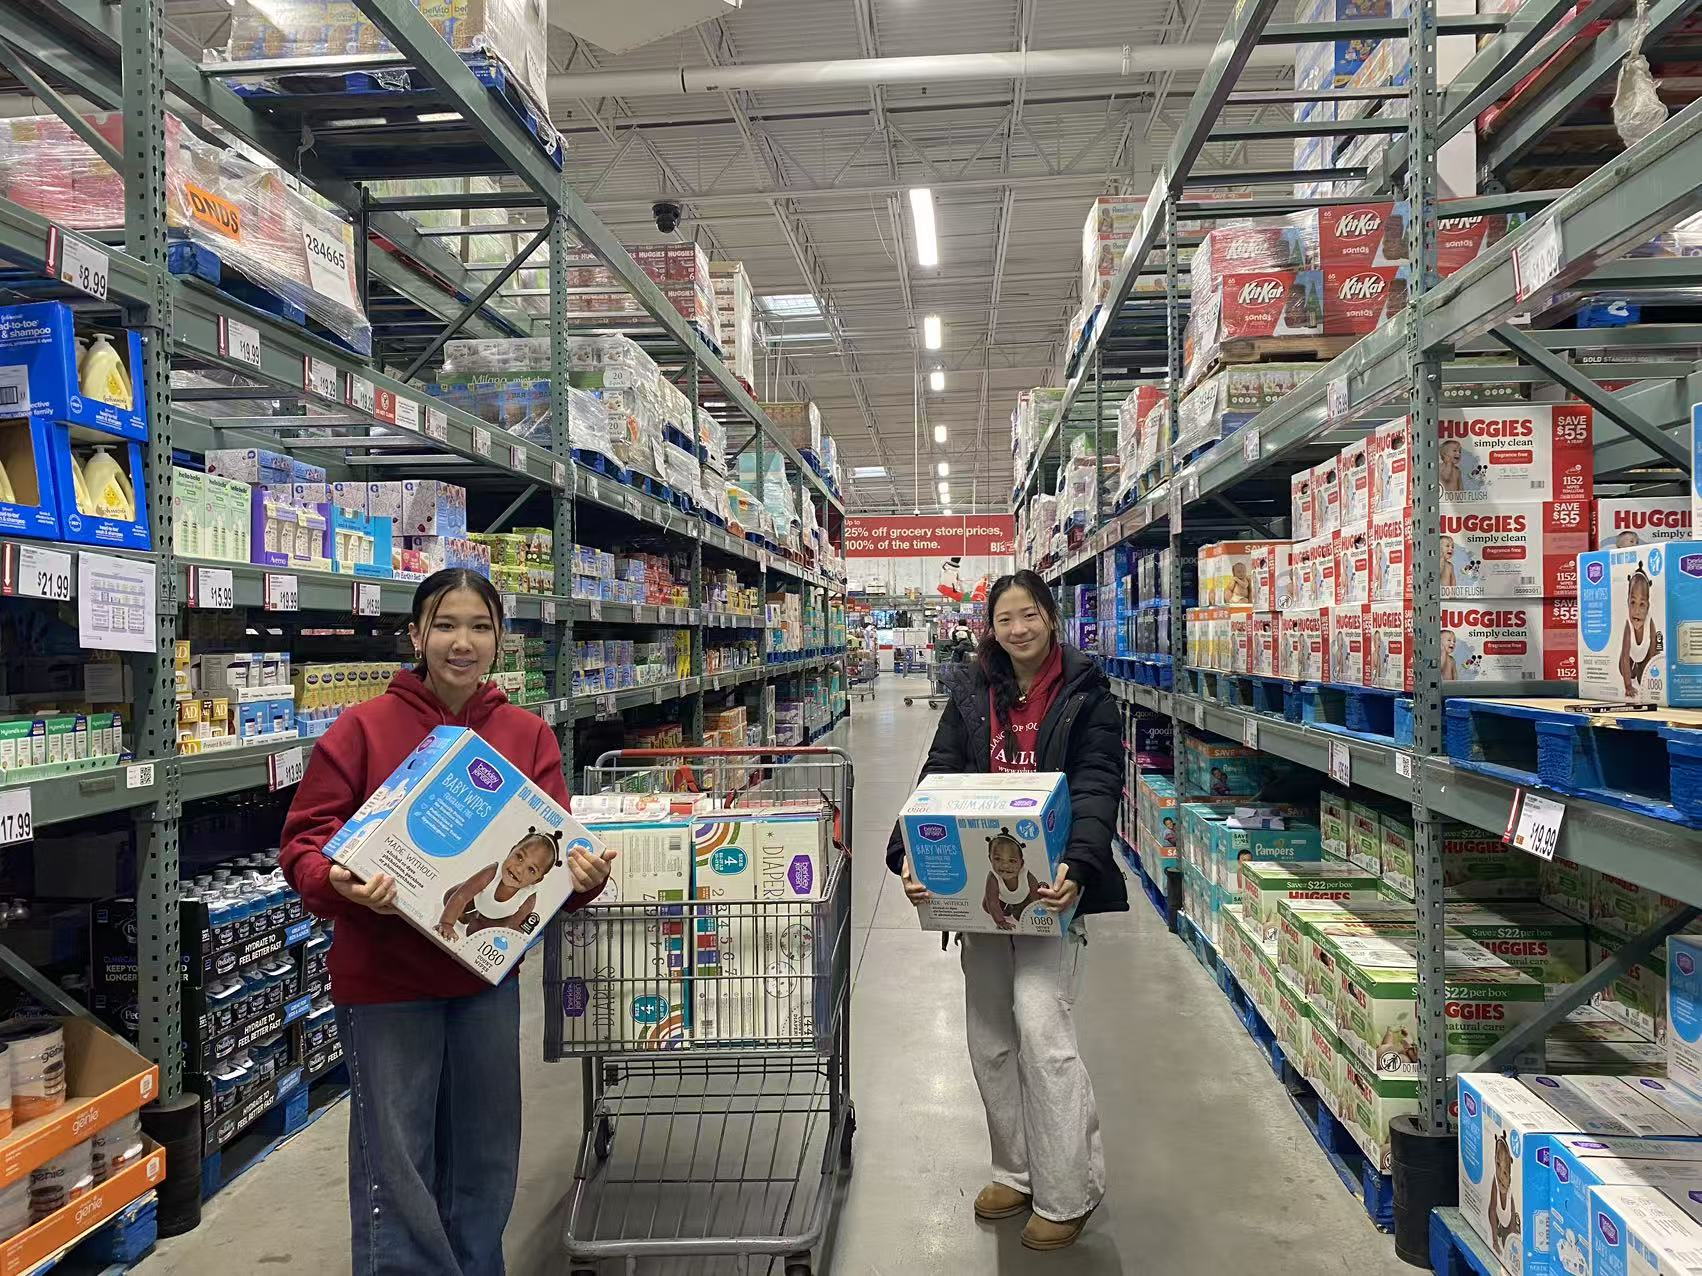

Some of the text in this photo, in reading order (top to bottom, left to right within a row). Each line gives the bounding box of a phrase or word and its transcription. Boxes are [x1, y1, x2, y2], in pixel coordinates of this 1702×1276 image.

[190, 191, 239, 234] DNDS
[1336, 214, 1382, 238] KitKat
[1342, 246, 1370, 255] santas
[1445, 240, 1474, 248] santas
[305, 233, 346, 270] 284665
[638, 250, 665, 258] HUGGIES
[79, 264, 106, 298] $8.99
[1238, 280, 1283, 304] KitKat
[1339, 277, 1386, 301] KitKat
[1244, 312, 1273, 322] santas
[1346, 308, 1374, 318] santas
[0, 319, 39, 331] ad-to-toe
[9, 327, 51, 339] shampoo
[239, 340, 260, 365] $19.99
[612, 372, 623, 380] 20
[33, 408, 54, 416] family
[608, 422, 619, 430] 20
[1558, 416, 1587, 425] SAVE
[1438, 419, 1533, 439] HUGGIES
[1556, 425, 1587, 440] $55
[1474, 437, 1533, 449] simply clean
[1563, 476, 1583, 485] 1152
[1445, 491, 1487, 500] DO NOT FLUSH
[1554, 503, 1580, 511] SAVE
[1553, 511, 1580, 525] $55
[1614, 509, 1692, 531] HUGGI
[845, 525, 1003, 538] 25% off grocery store prices,
[1374, 520, 1402, 540] HUGGIES
[1652, 529, 1685, 539] simply
[845, 539, 941, 550] 100% of the time.
[1467, 534, 1526, 544] simply clean
[990, 542, 1006, 553] BJ's
[1556, 572, 1577, 581] 1152
[37, 571, 69, 599] $21.99
[1441, 587, 1484, 596] DO NOT FLUSH
[211, 587, 232, 607] $15.99
[280, 591, 297, 609] $19.99
[1584, 588, 1608, 600] BABY WIPES
[1372, 611, 1402, 629] HUGGIES
[1553, 608, 1578, 620] $55
[1298, 618, 1321, 632] HUGGIES
[1336, 614, 1361, 630] HUGGIES
[1468, 629, 1527, 639] simply clean
[1557, 668, 1577, 677] 1152
[1648, 678, 1662, 690] 1080
[477, 763, 500, 784] berkley
[442, 772, 492, 818] BABY WIPES
[518, 787, 563, 828] DO NOT FLUSH
[978, 801, 1007, 810] BABY
[958, 818, 1000, 829] DO NOT FLUSH
[1461, 829, 1481, 838] $22
[1530, 822, 1556, 857] $19.99
[916, 844, 957, 856] BABY WIPES
[1255, 843, 1295, 856] Pampers
[1443, 840, 1509, 854] HUGGIES
[384, 836, 438, 881] MADE WITHOUT
[386, 849, 401, 863] alcohol
[763, 845, 785, 900] DIAPER
[801, 861, 809, 890] berkley
[404, 871, 425, 889] parabens
[1286, 881, 1302, 889] Save
[1308, 881, 1326, 890] $22
[1030, 916, 1053, 926] 1080
[1472, 928, 1553, 938] Save $22 per box
[245, 934, 276, 954] HYDRATE TO
[239, 940, 282, 966] FEEL BETTER FAST
[476, 940, 505, 967] 1080
[474, 958, 490, 974] WIPES
[477, 955, 494, 970] COUNT
[106, 965, 138, 974] KEEP YO
[1470, 988, 1508, 1000] per box
[1445, 1002, 1505, 1020] GGIES
[244, 1012, 276, 1035] HYDRATE TO
[1483, 1023, 1505, 1031] care
[238, 1019, 281, 1048] FEEL BETTER FAST
[327, 1051, 338, 1063] FEEL
[1403, 1064, 1412, 1072] DO
[237, 1095, 275, 1130] FEEL BETTER FAST
[243, 1098, 263, 1117] HYDRATE
[72, 1107, 99, 1135] genie
[74, 1195, 103, 1225] genie
